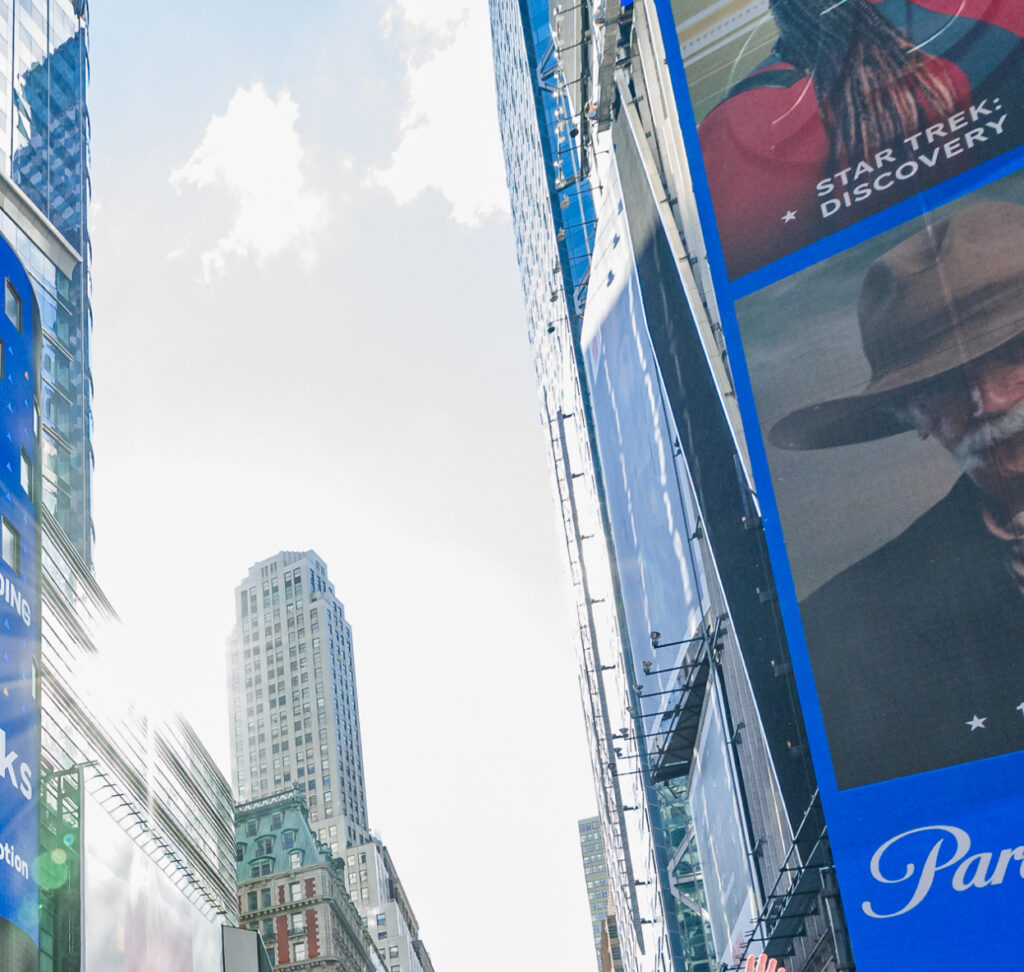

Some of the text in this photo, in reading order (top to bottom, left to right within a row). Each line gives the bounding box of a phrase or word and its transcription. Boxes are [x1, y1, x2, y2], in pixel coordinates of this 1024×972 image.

[816, 97, 1003, 198] STAR TREK:
[820, 114, 1007, 219] DISCOVERY
[861, 824, 1024, 919] Par
